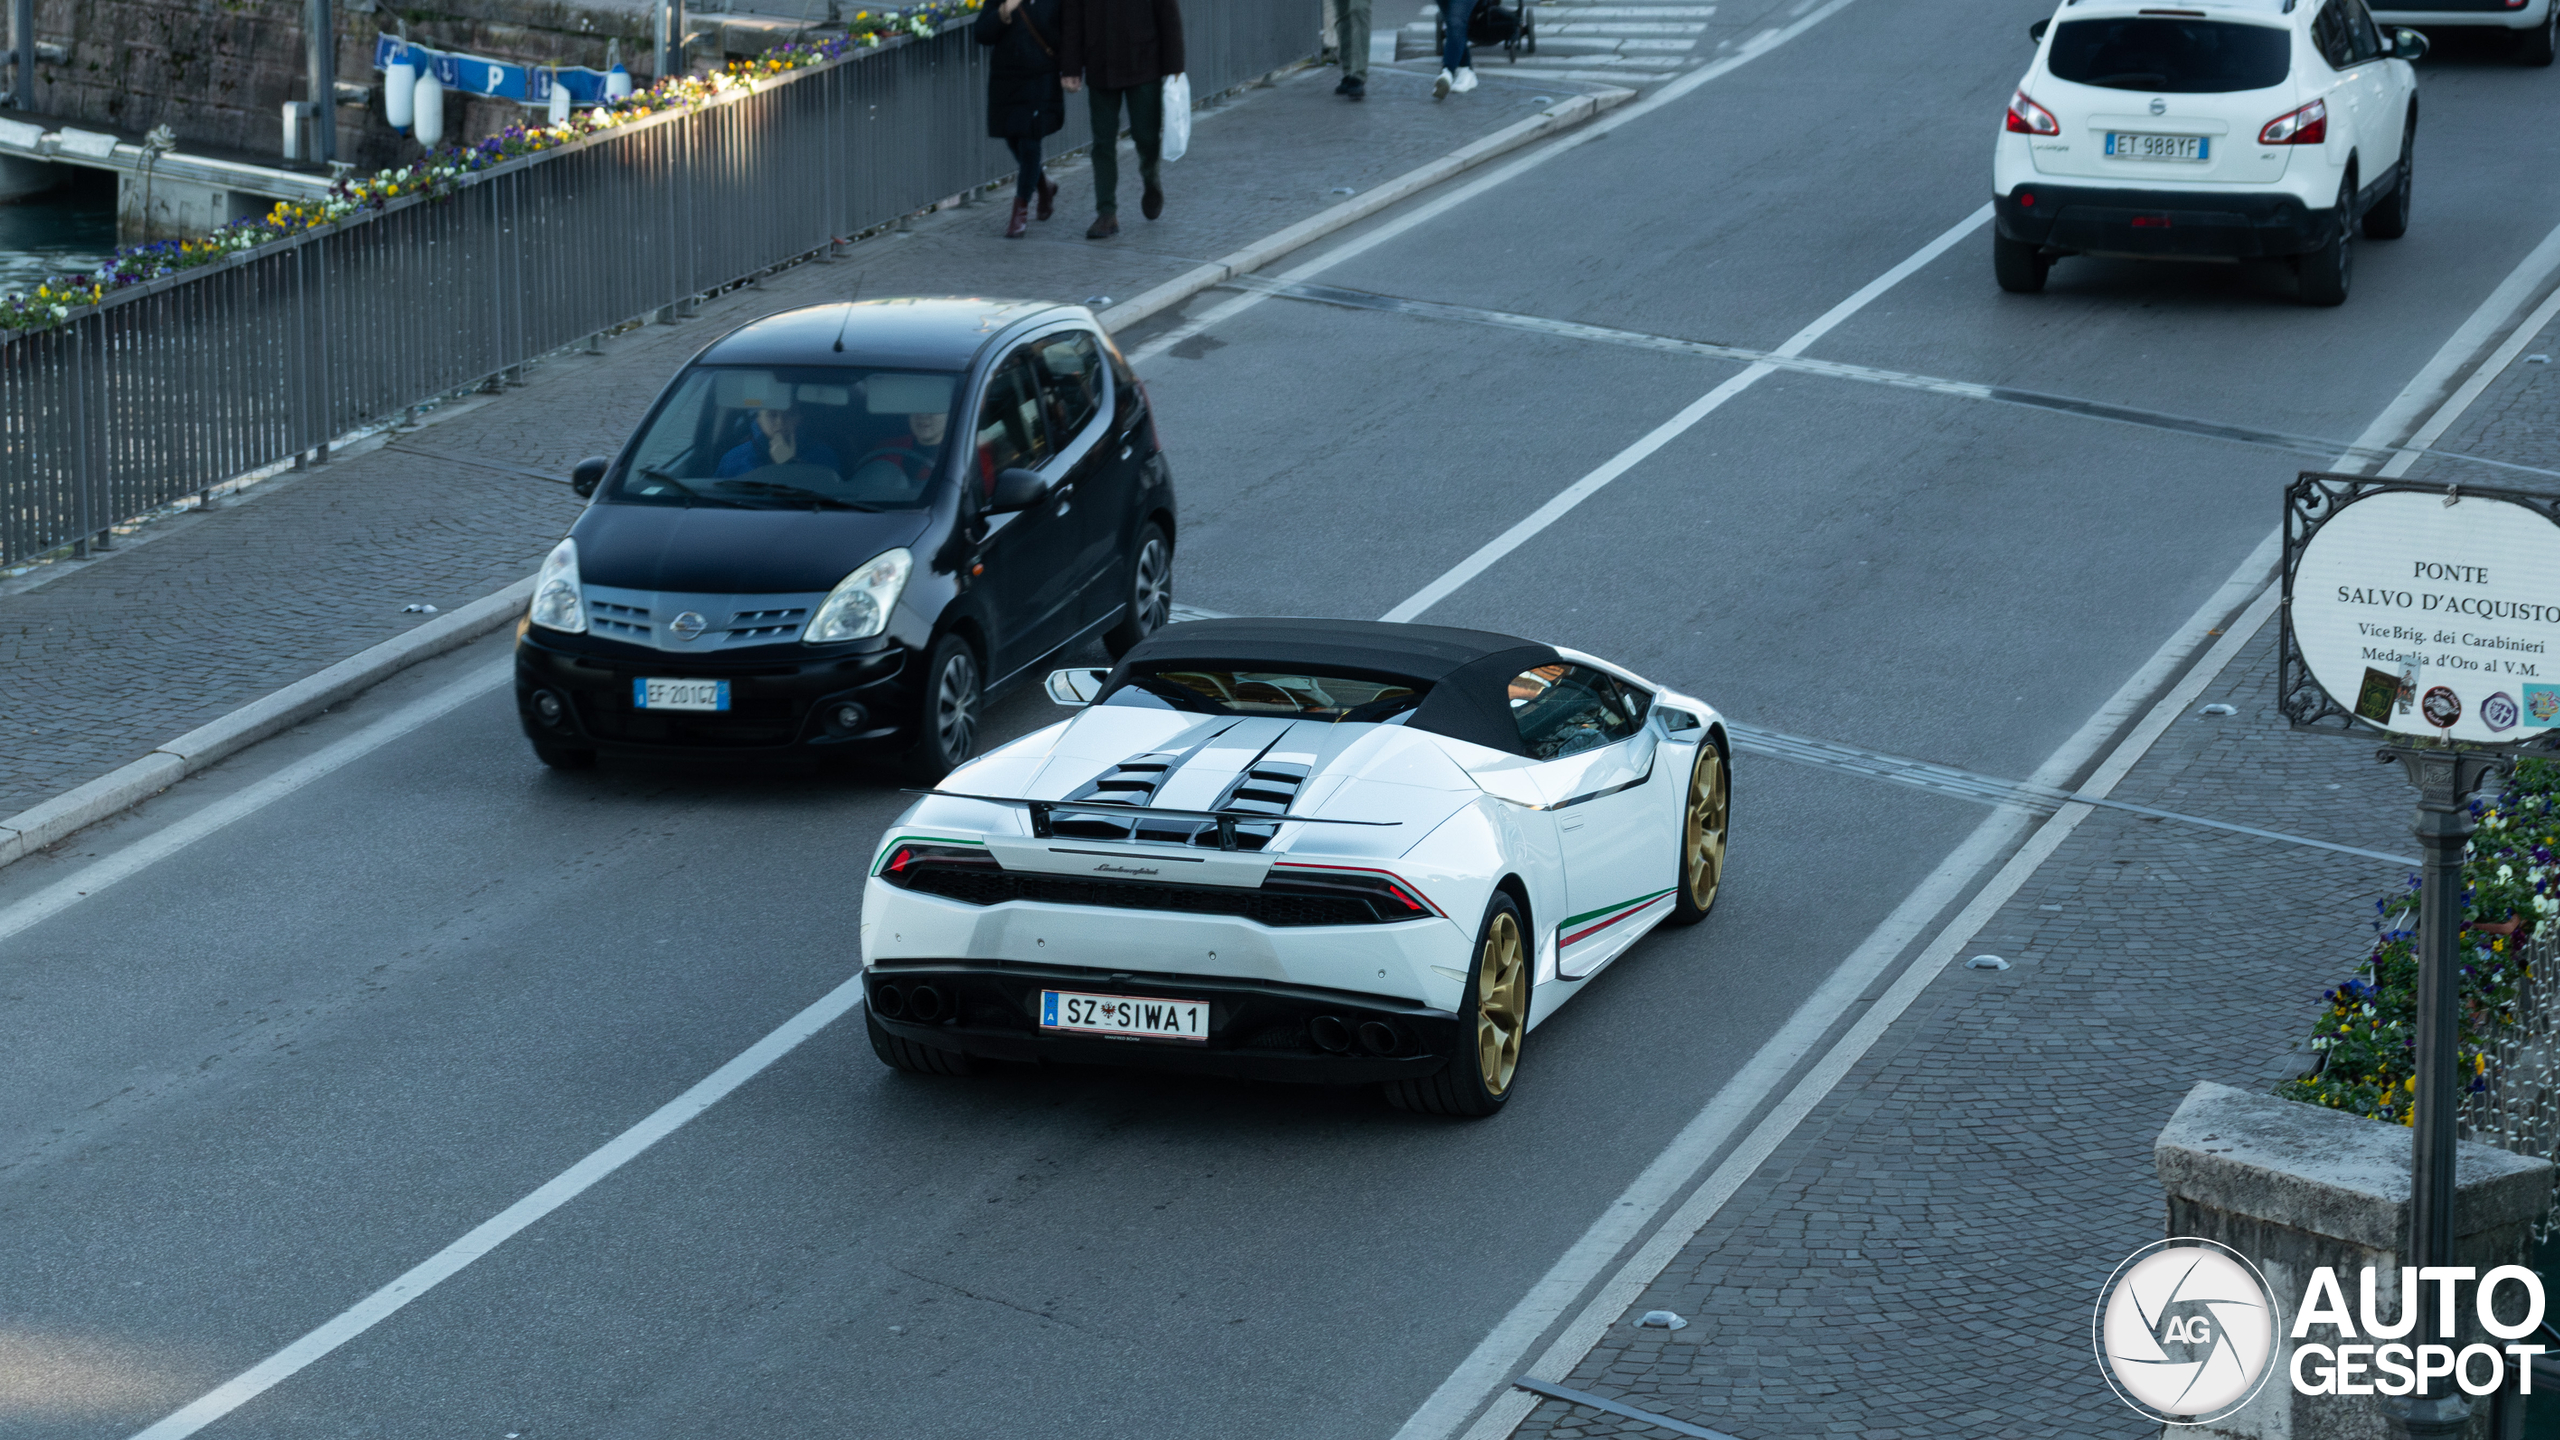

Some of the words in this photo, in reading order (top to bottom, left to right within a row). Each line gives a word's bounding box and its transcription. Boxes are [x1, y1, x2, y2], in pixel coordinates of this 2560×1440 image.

[2117, 136, 2139, 153] ET
[2144, 137, 2198, 157] 988YF
[2414, 561, 2489, 585] PONTE
[2337, 586, 2413, 608] SALVO
[2422, 593, 2560, 623] D'ACQUISTO
[2358, 622, 2391, 638] Vice
[2393, 626, 2427, 645] Brig.
[2433, 630, 2456, 644] dei
[2462, 632, 2545, 653] Carabinieri
[2361, 646, 2430, 665] Medalia
[2436, 654, 2478, 670] d'Oro
[2484, 659, 2498, 672] al
[2504, 661, 2540, 676] V.M.
[1047, 1013, 1055, 1021] A
[1067, 998, 1097, 1025] SZ
[1117, 1002, 1180, 1032] SIWA
[1187, 1007, 1197, 1033] 1
